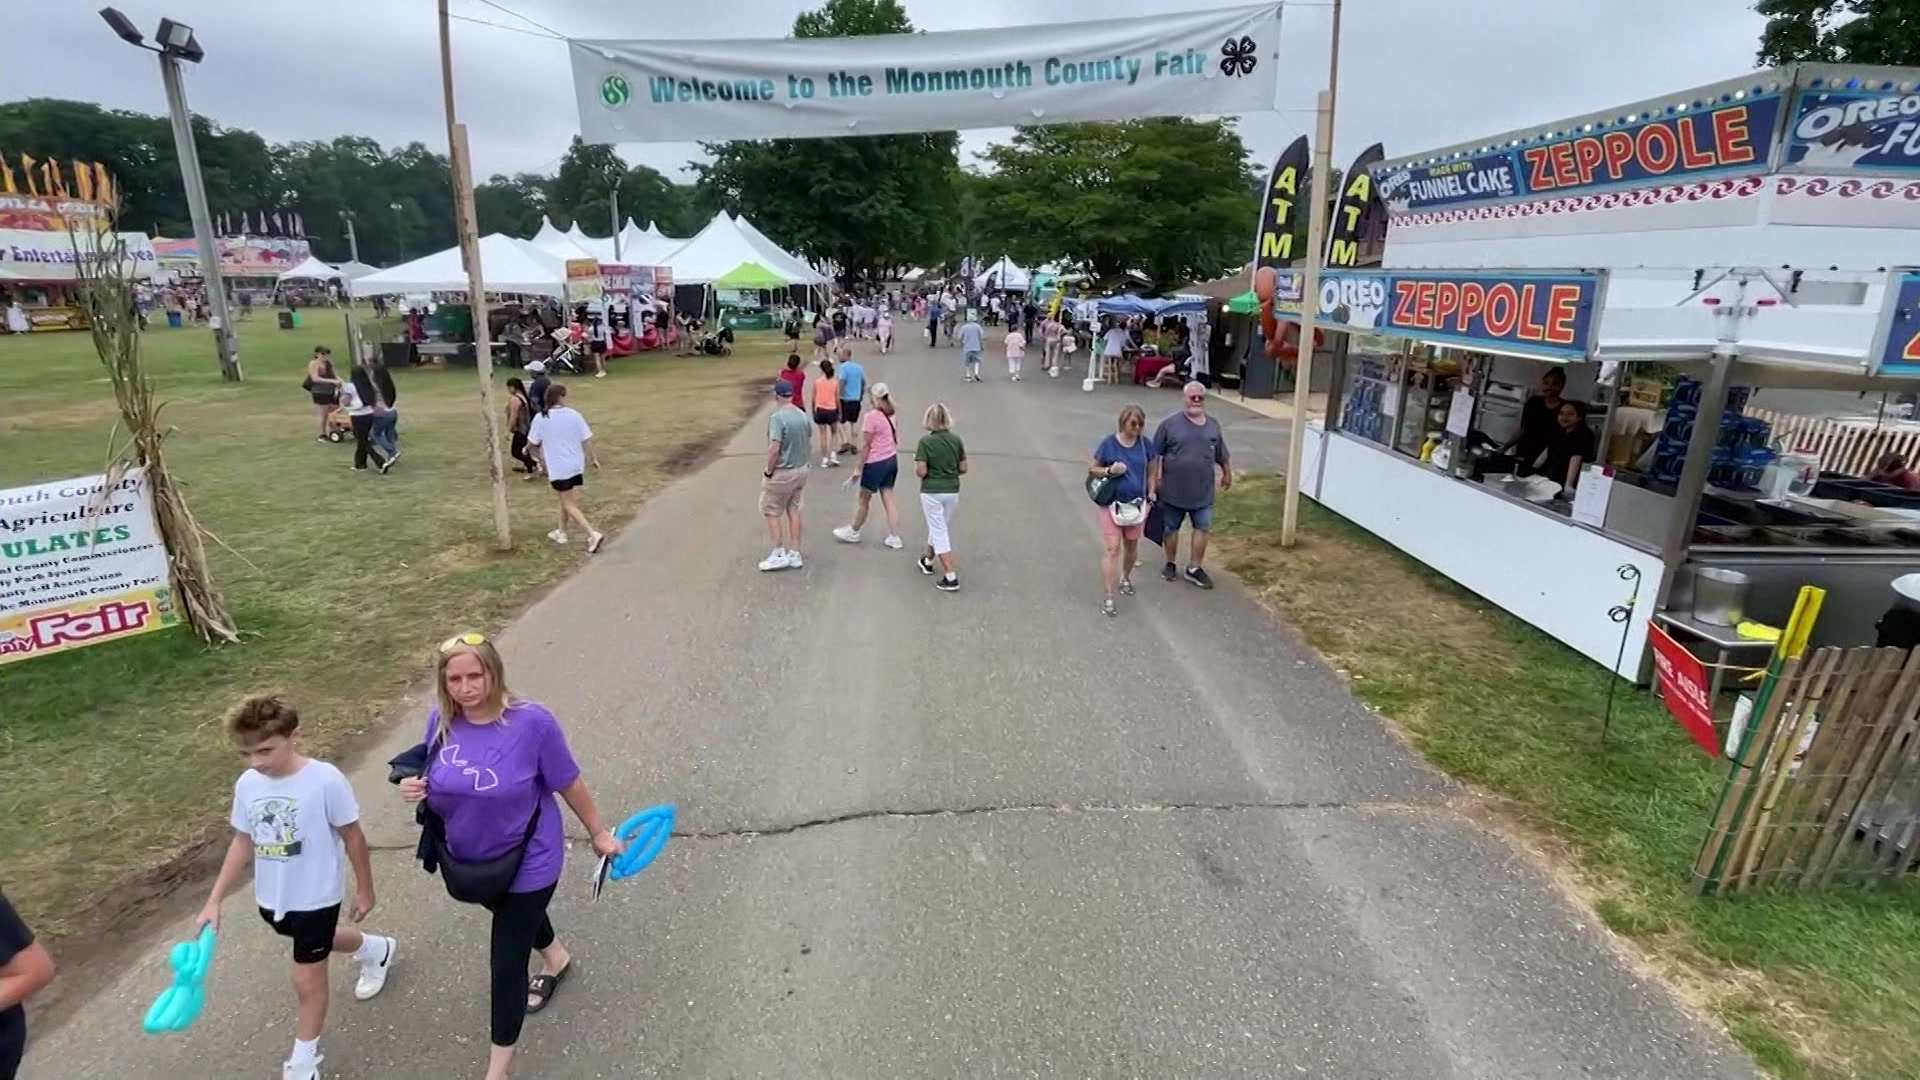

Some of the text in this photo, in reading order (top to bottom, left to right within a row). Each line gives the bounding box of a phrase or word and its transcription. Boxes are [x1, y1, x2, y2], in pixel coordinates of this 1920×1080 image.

[650, 48, 1208, 103] Welcome to the Monmouth County Fair
[1796, 95, 1920, 139] OREO
[1525, 106, 1755, 191] ZEPPOLE
[1408, 167, 1513, 201] FUNNEL CAKE
[1261, 166, 1298, 259] ATM
[1330, 174, 1371, 267] ATM
[1319, 279, 1384, 314] OREO
[1392, 280, 1581, 345] ZEPPOLE
[1, 525, 131, 558] ULATES
[18, 590, 88, 608] Monmouth
[90, 582, 131, 594] County
[30, 602, 149, 648] Fair
